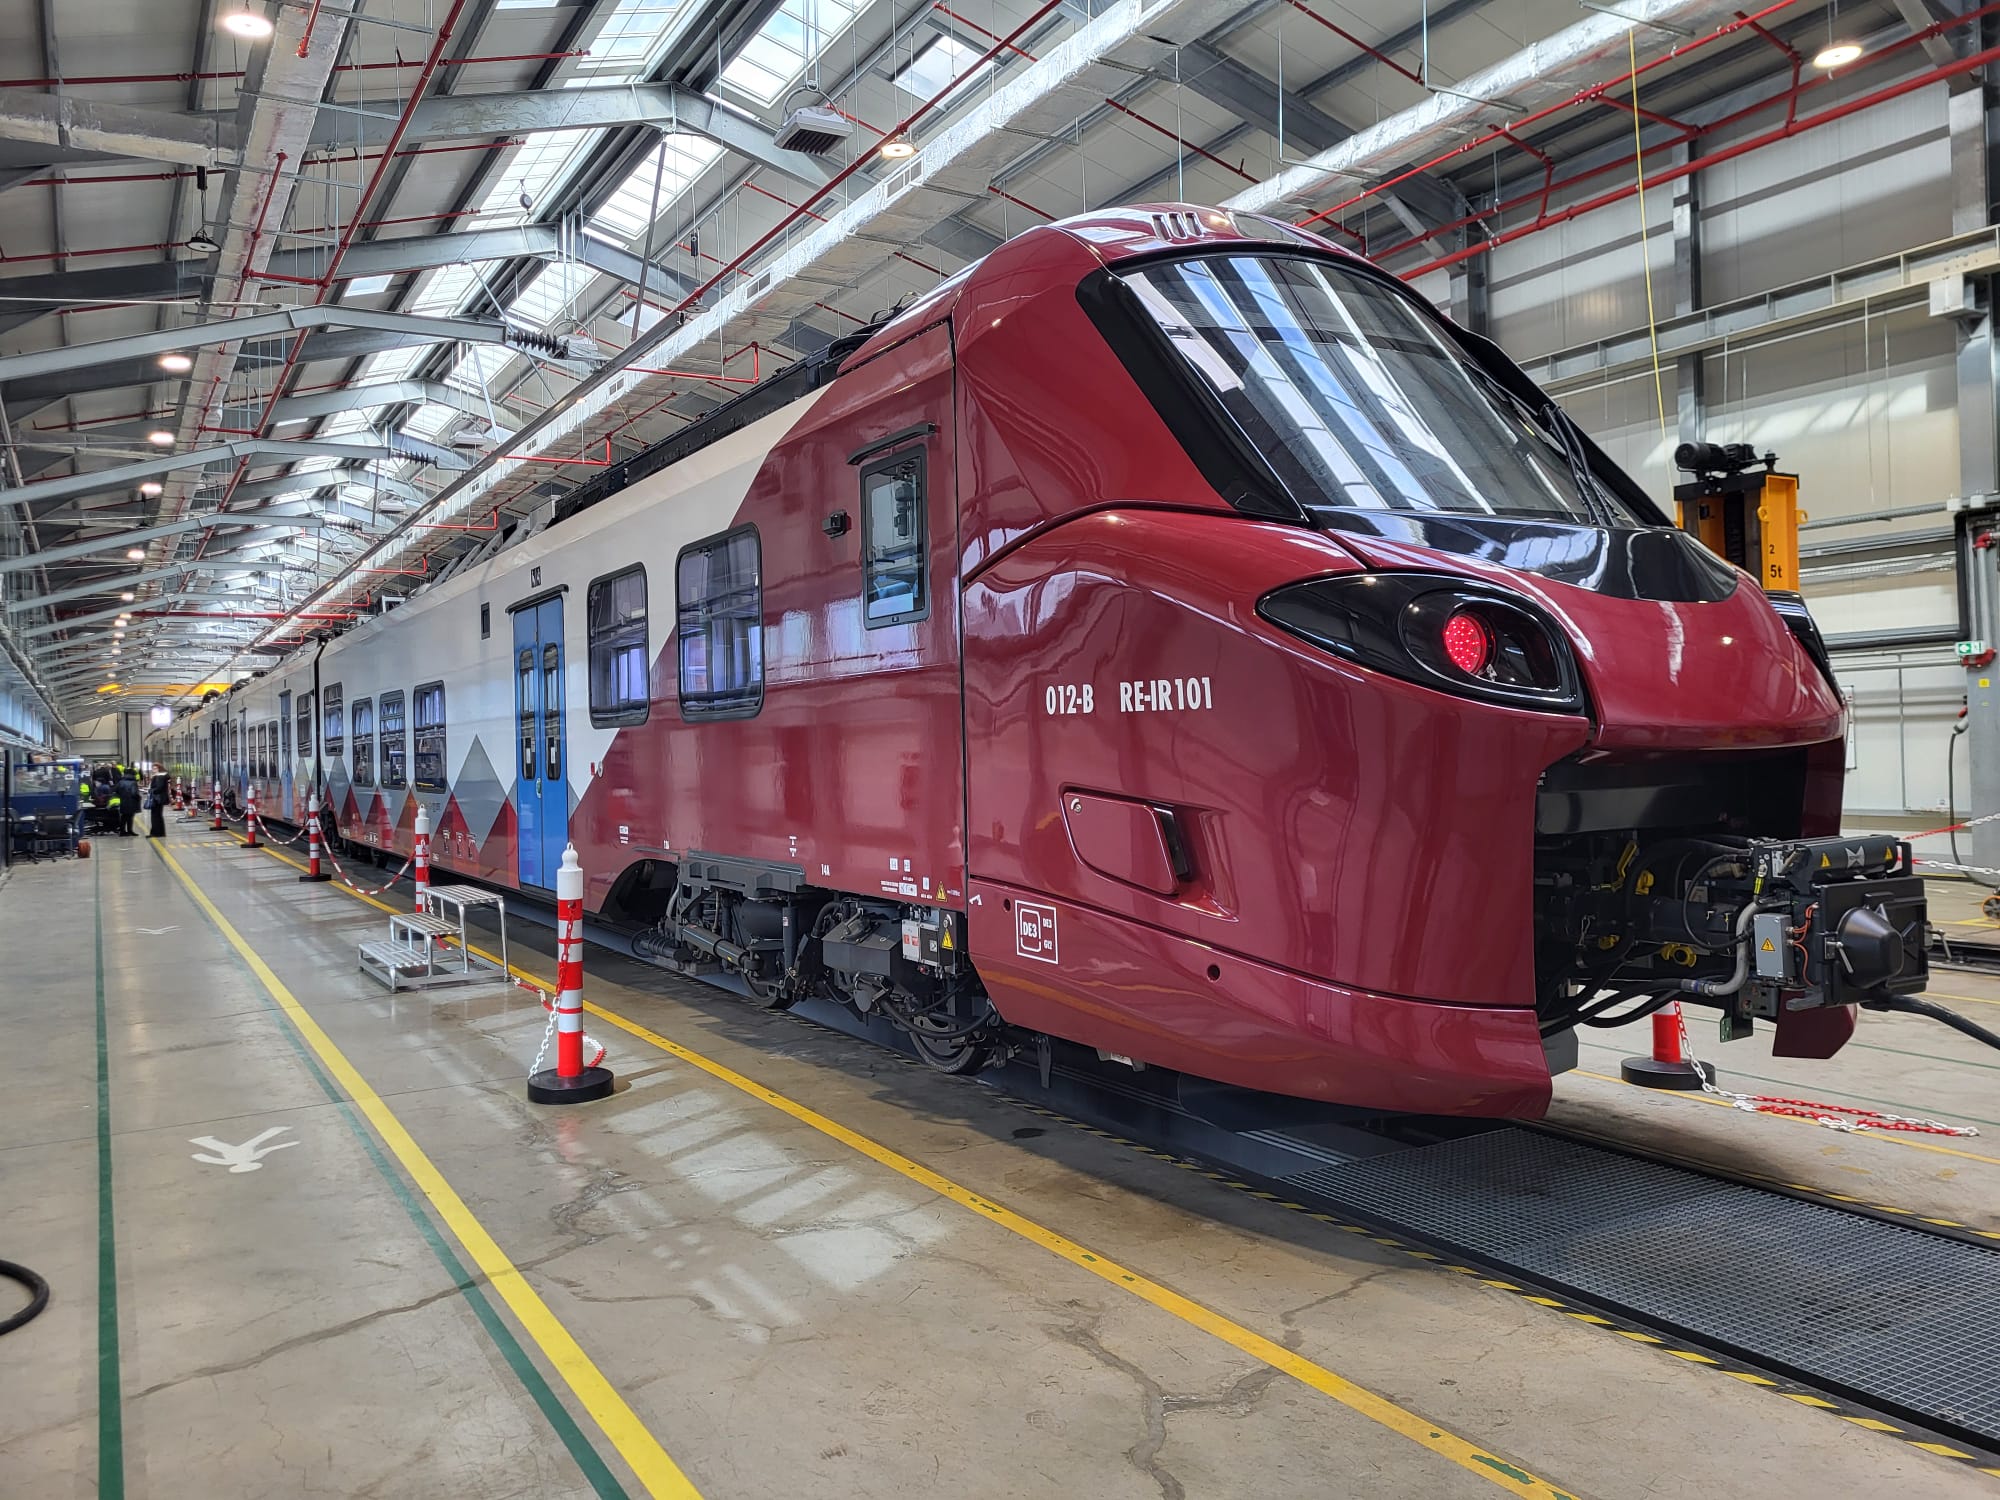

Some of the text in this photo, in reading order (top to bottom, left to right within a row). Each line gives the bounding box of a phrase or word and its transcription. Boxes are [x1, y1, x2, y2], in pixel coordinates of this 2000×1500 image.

[1769, 544, 1775, 554] 2
[1770, 565, 1782, 578] 5t
[1046, 684, 1094, 715] 012-B
[1023, 921, 1037, 938] DE3
